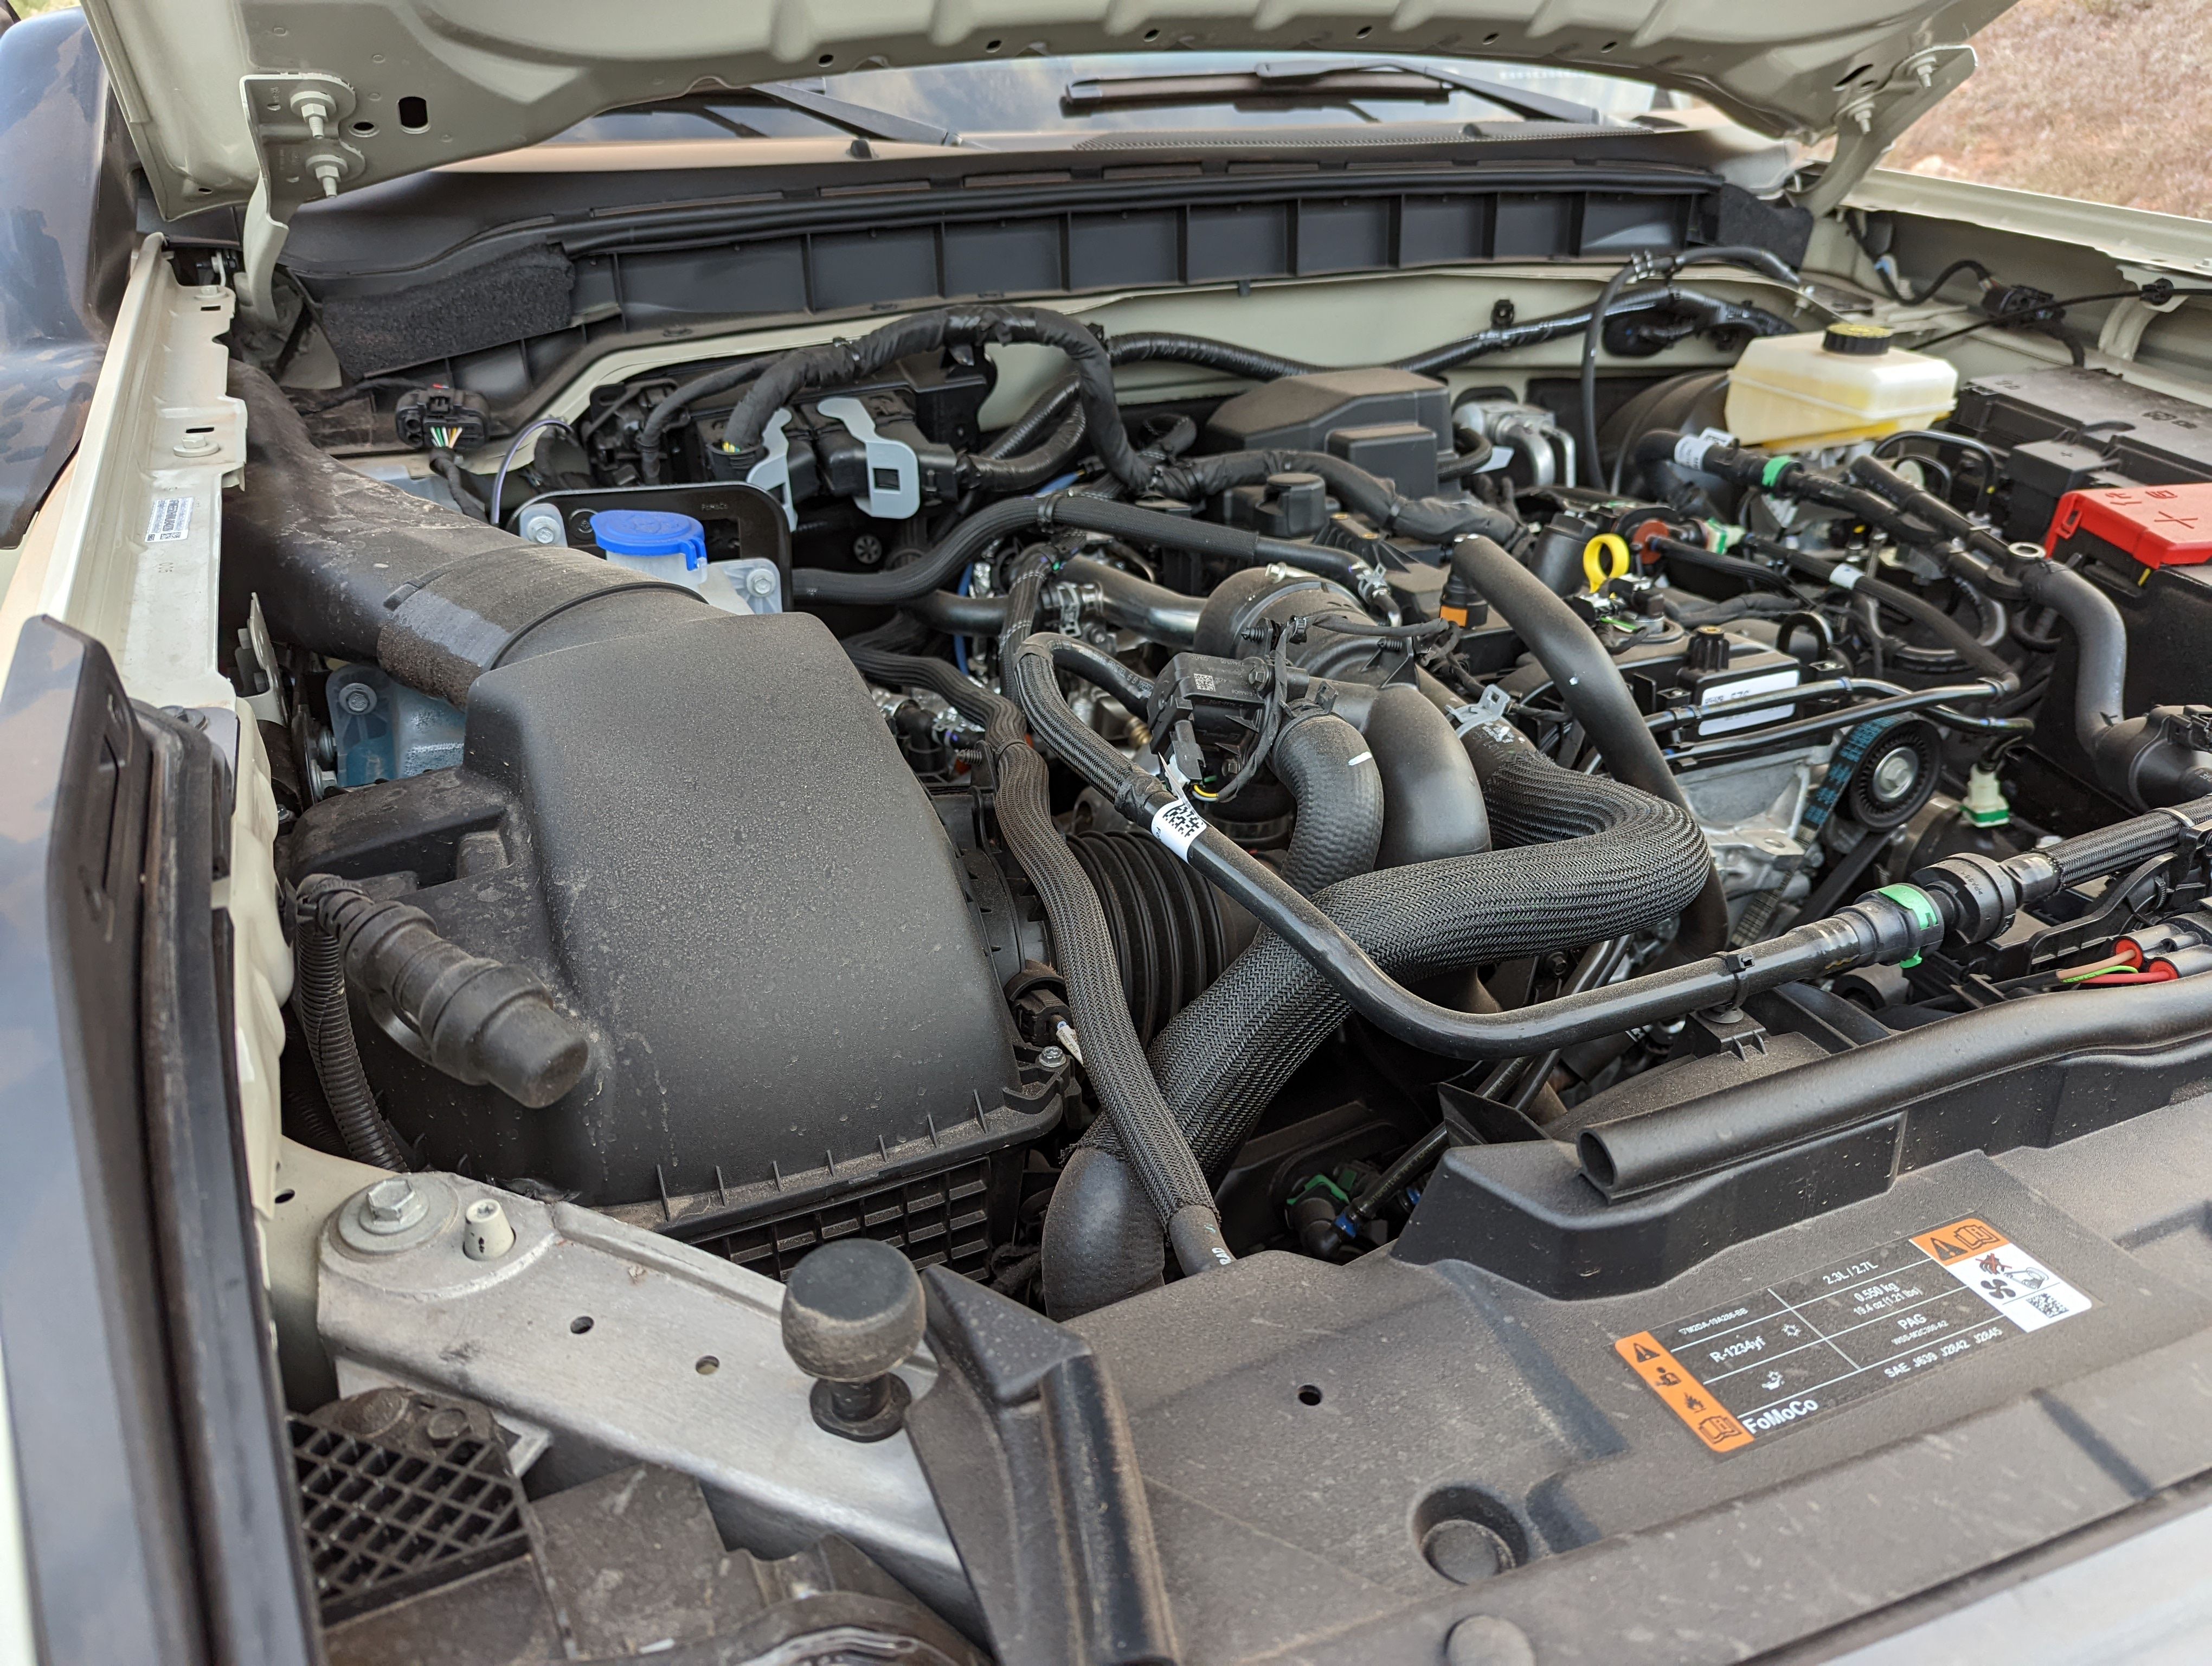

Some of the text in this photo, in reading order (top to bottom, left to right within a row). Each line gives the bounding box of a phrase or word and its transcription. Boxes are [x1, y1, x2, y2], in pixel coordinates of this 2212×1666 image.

[1212, 1248, 1231, 1265] RAD
[1822, 1270, 1849, 1285] 2.3L
[1851, 1261, 1879, 1275] 2.7L
[1853, 1281, 1900, 1302] 0.550 kg
[1873, 1301, 1886, 1310] oz
[1883, 1292, 1906, 1307] (1.21
[1901, 1286, 1924, 1299] lbs)
[1897, 1313, 1927, 1330] PAG
[1709, 1335, 1767, 1363] R-1234yf
[1883, 1327, 2004, 1378] SAE J639 J2842 J2845
[1742, 1400, 1819, 1434] FoMoCo
